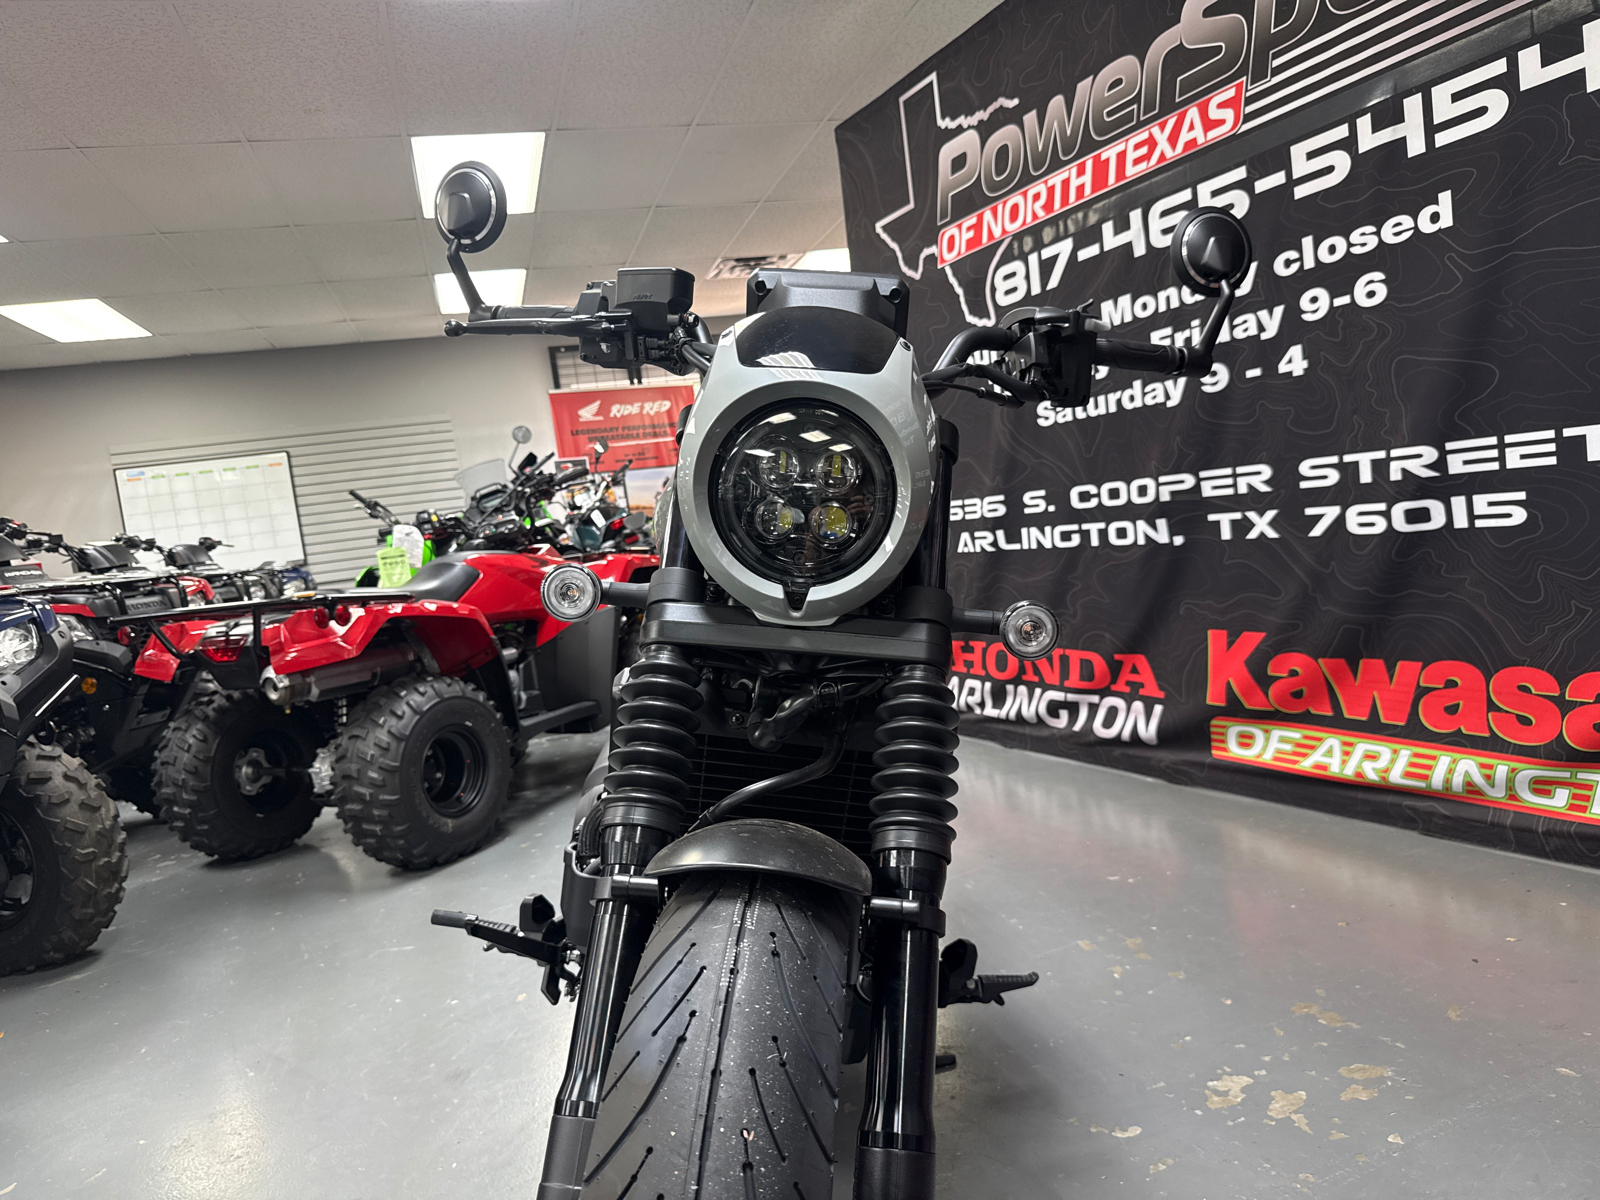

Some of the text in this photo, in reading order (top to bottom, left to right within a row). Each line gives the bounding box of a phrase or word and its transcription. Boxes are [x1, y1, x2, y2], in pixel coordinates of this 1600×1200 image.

[937, 0, 1373, 226] PowerSp
[940, 225, 978, 263] OF
[982, 161, 1093, 245] NORTH
[1099, 86, 1238, 188] TEXAS
[993, 17, 1600, 308] 817-465-5454
[1100, 189, 1454, 329] Mony closed
[1299, 271, 1388, 322] 9-6
[1200, 361, 1231, 394] 9
[1277, 343, 1309, 377] 4
[609, 400, 671, 418] RIDE RED
[621, 422, 677, 432] PERFORMANC
[1023, 489, 1056, 515] S.
[1069, 463, 1274, 510] COOPER
[1298, 424, 1600, 489] STREET
[1207, 509, 1281, 541] TX
[1304, 490, 1528, 537] 76015
[951, 640, 1166, 699] HONDA
[947, 675, 1164, 745] ARLINGTON
[1226, 725, 1302, 760] OF
